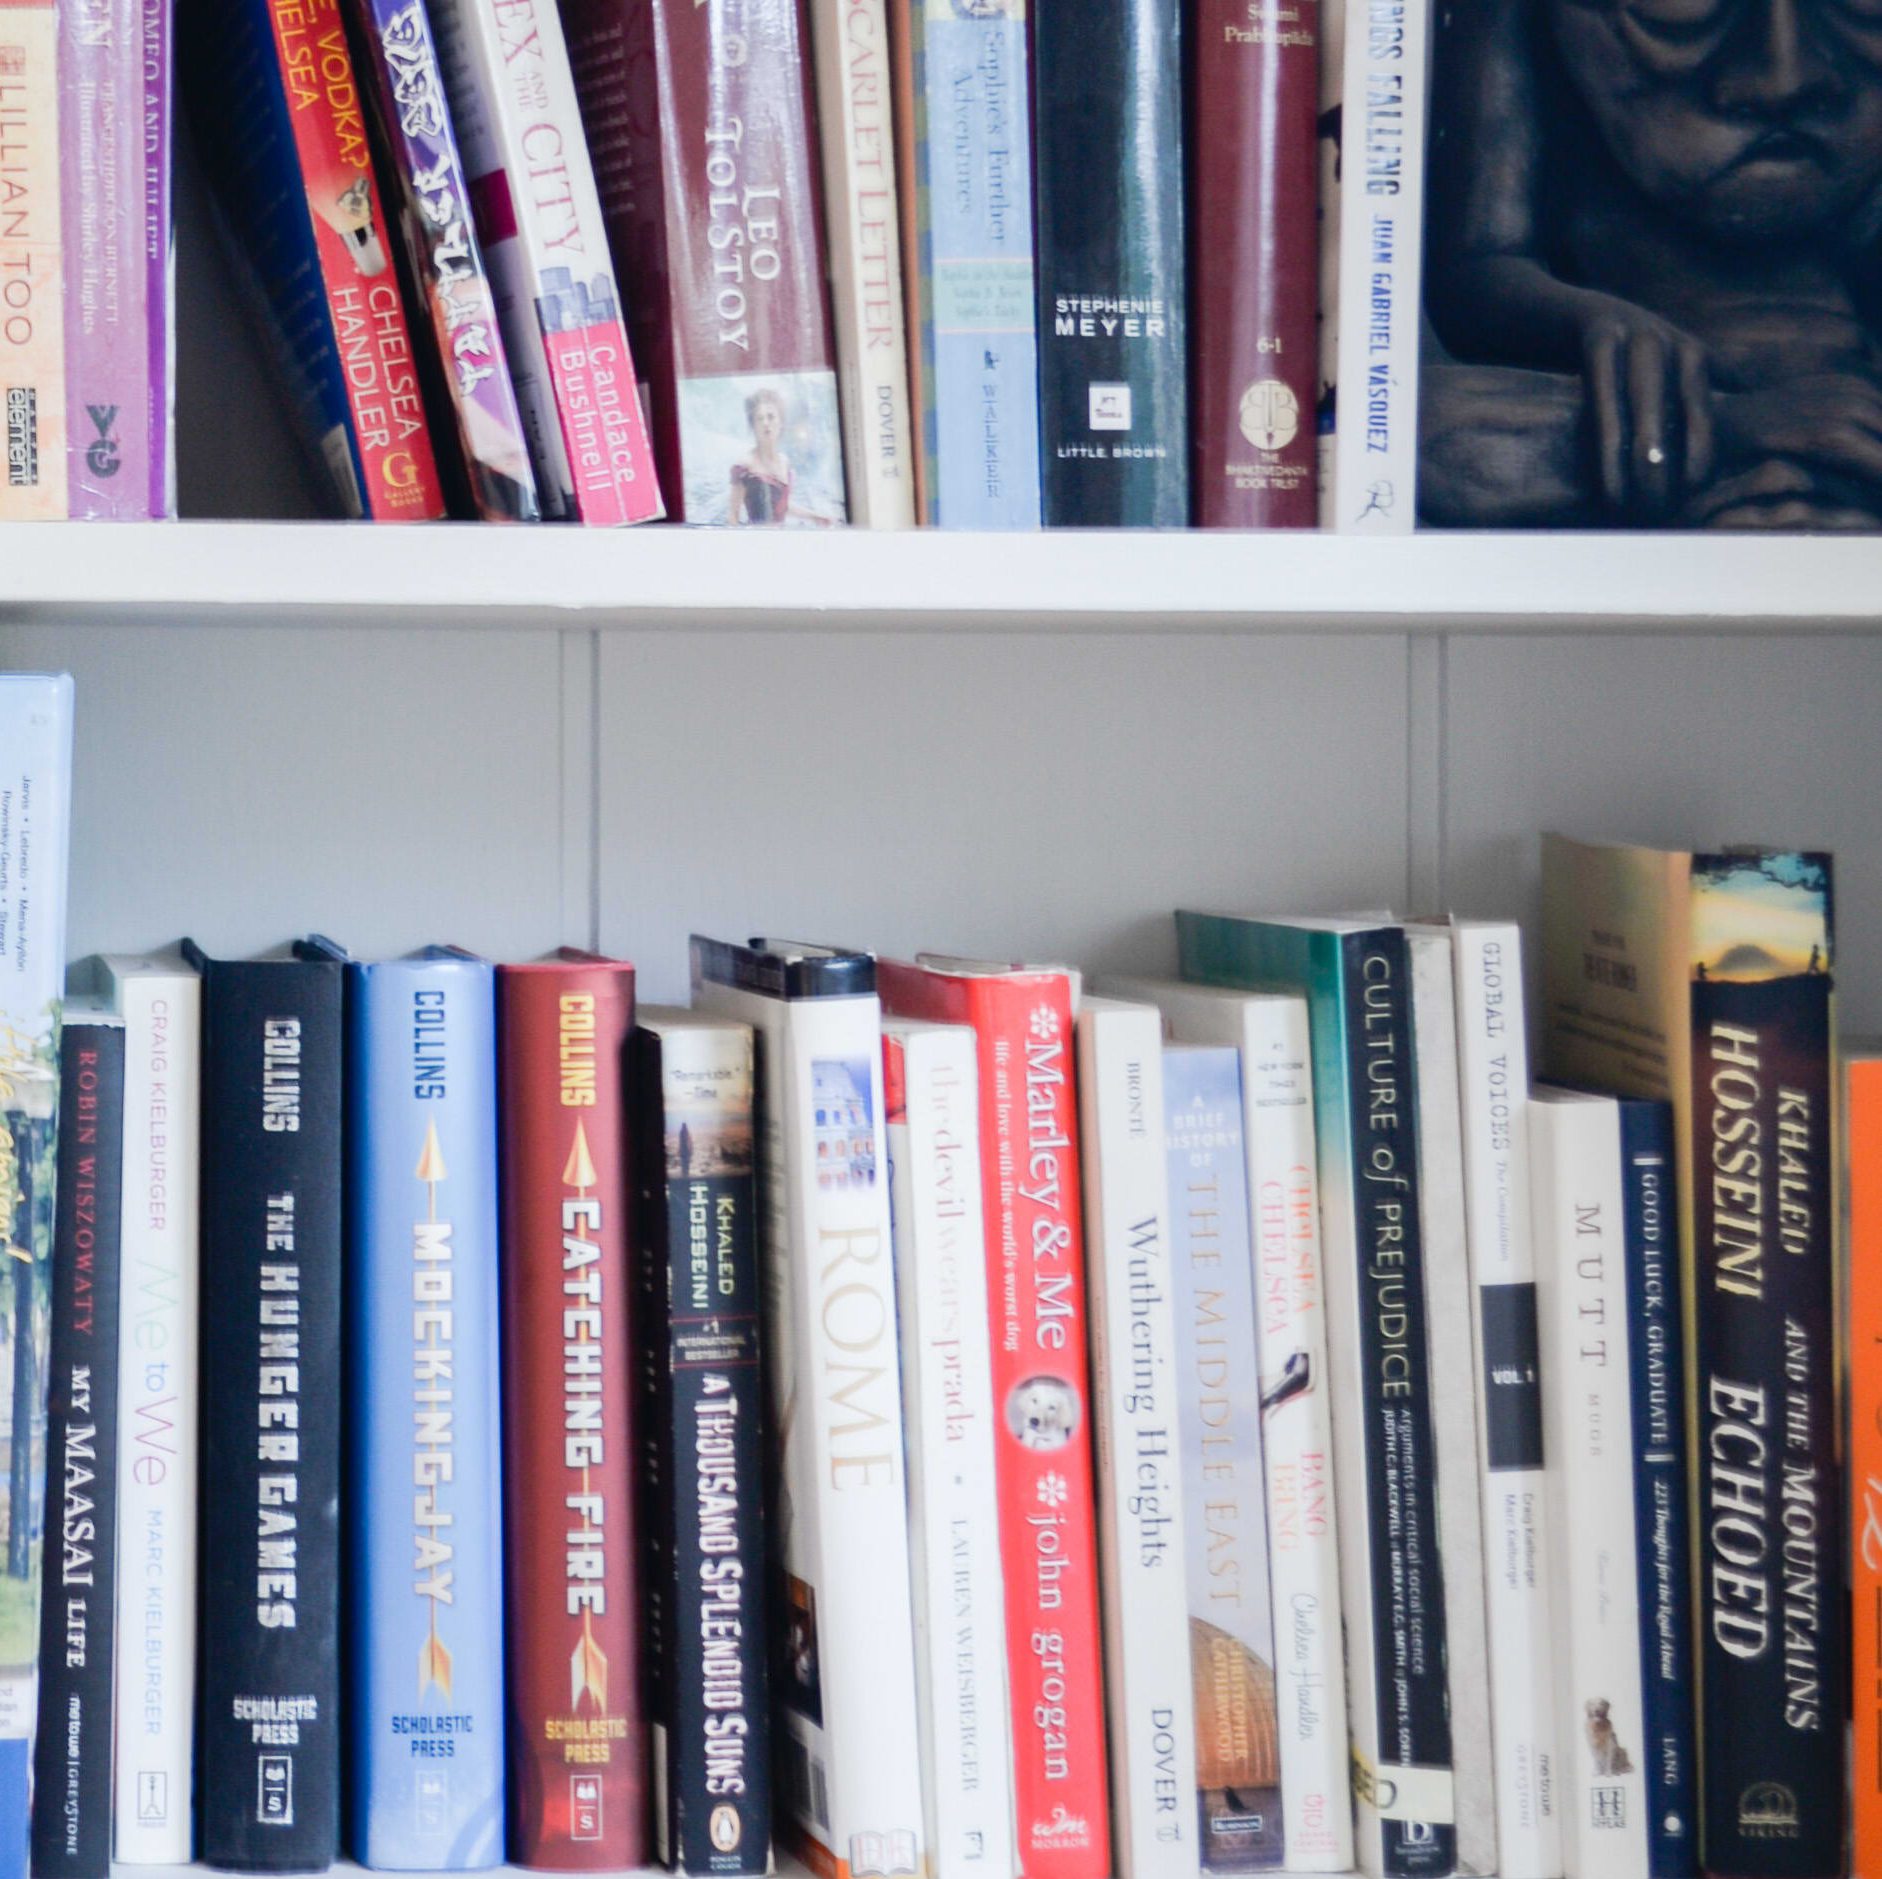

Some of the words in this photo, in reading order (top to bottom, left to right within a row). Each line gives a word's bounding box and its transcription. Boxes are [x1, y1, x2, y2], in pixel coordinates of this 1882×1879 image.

[318, 31, 368, 168] VODKA?
[531, 71, 550, 111] AND
[1364, 73, 1405, 197] FALLING
[520, 122, 585, 256] CITY
[704, 117, 749, 352] TOLSTOY
[743, 187, 782, 281] LEO
[4, 252, 34, 347] TOO
[1055, 292, 1164, 314] STEPHENIE
[1055, 315, 1166, 337] MEYER
[333, 288, 391, 451] HANDLER
[366, 285, 422, 440] CHELSEA
[559, 352, 614, 491] Bushnell
[588, 345, 639, 484] Candace
[875, 384, 899, 459] DOVER
[1482, 940, 1507, 1039] GLOBAL
[149, 999, 168, 1073] CRAIG
[414, 991, 446, 1100] COLLINS
[558, 993, 597, 1107] COLLINS
[994, 1040, 1011, 1069] life
[1362, 957, 1398, 1130] CULTURE
[77, 1051, 99, 1145] ROBIN
[262, 1018, 302, 1133] COLLINS
[1487, 1055, 1511, 1151] VOICES
[148, 1081, 168, 1231] KIELBURGER
[995, 1102, 1012, 1135] love
[1019, 1036, 1071, 1211] Marley
[997, 1139, 1015, 1178] with
[999, 1181, 1016, 1207] the
[1364, 1148, 1410, 1190] of
[1710, 1020, 1764, 1301] HOSSEINI
[1777, 1084, 1812, 1254] KHALED
[266, 1192, 296, 1252] THE
[1001, 1211, 1018, 1269] world's
[1495, 1186, 1511, 1262] Compilation
[1641, 1173, 1664, 1241] GOOD
[688, 1185, 710, 1309] HOSSEINI
[716, 1197, 735, 1296] KHALED
[1642, 1250, 1665, 1319] LUCK,
[1003, 1272, 1020, 1317] worst
[1035, 1273, 1076, 1350] Me
[1123, 1216, 1164, 1414] Wuthering
[1368, 1203, 1411, 1399] PREJUDICE
[258, 1262, 301, 1462] HUNGER
[818, 1225, 898, 1491] ROME
[1002, 1320, 1022, 1352] dog
[1784, 1318, 1809, 1381] AND
[70, 1365, 91, 1414] MY
[702, 1374, 732, 1395] A
[1647, 1326, 1667, 1444] GRADUATE
[1784, 1391, 1810, 1451] THE
[1383, 1409, 1399, 1449] JUDITH
[1398, 1409, 1416, 1491] Arguments
[61, 1422, 97, 1587] MAASAI
[1128, 1427, 1174, 1569] Heights
[1386, 1469, 1401, 1538] BLACKWELL
[1404, 1493, 1416, 1507] in
[1654, 1481, 1668, 1506] 223
[1709, 1375, 1769, 1661] ECHOED
[144, 1510, 164, 1576] MARC
[257, 1473, 298, 1629] GAMES
[565, 1493, 606, 1615] FIRE
[1025, 1512, 1070, 1611] john
[1405, 1510, 1421, 1565] critical
[1652, 1509, 1671, 1561] Thoughts
[1653, 1561, 1670, 1583] for
[1408, 1568, 1423, 1615] social
[1657, 1584, 1671, 1604] the
[1781, 1463, 1820, 1731] MOUNTAINS
[65, 1597, 87, 1669] LIFE
[143, 1588, 165, 1735] KIELBURGER
[1393, 1629, 1406, 1666] SMITH
[1410, 1617, 1425, 1675] science
[1659, 1644, 1675, 1680] Ahead
[390, 1715, 474, 1734] SCHOLASTIC
[544, 1718, 628, 1739] SCHOLASTIC
[1029, 1631, 1070, 1781] grogan
[1394, 1678, 1409, 1712] JOHN
[410, 1740, 456, 1758] PRESS
[563, 1743, 611, 1763] PRESS
[1150, 1708, 1178, 1813] DOVER
[1663, 1737, 1679, 1785] LANG
